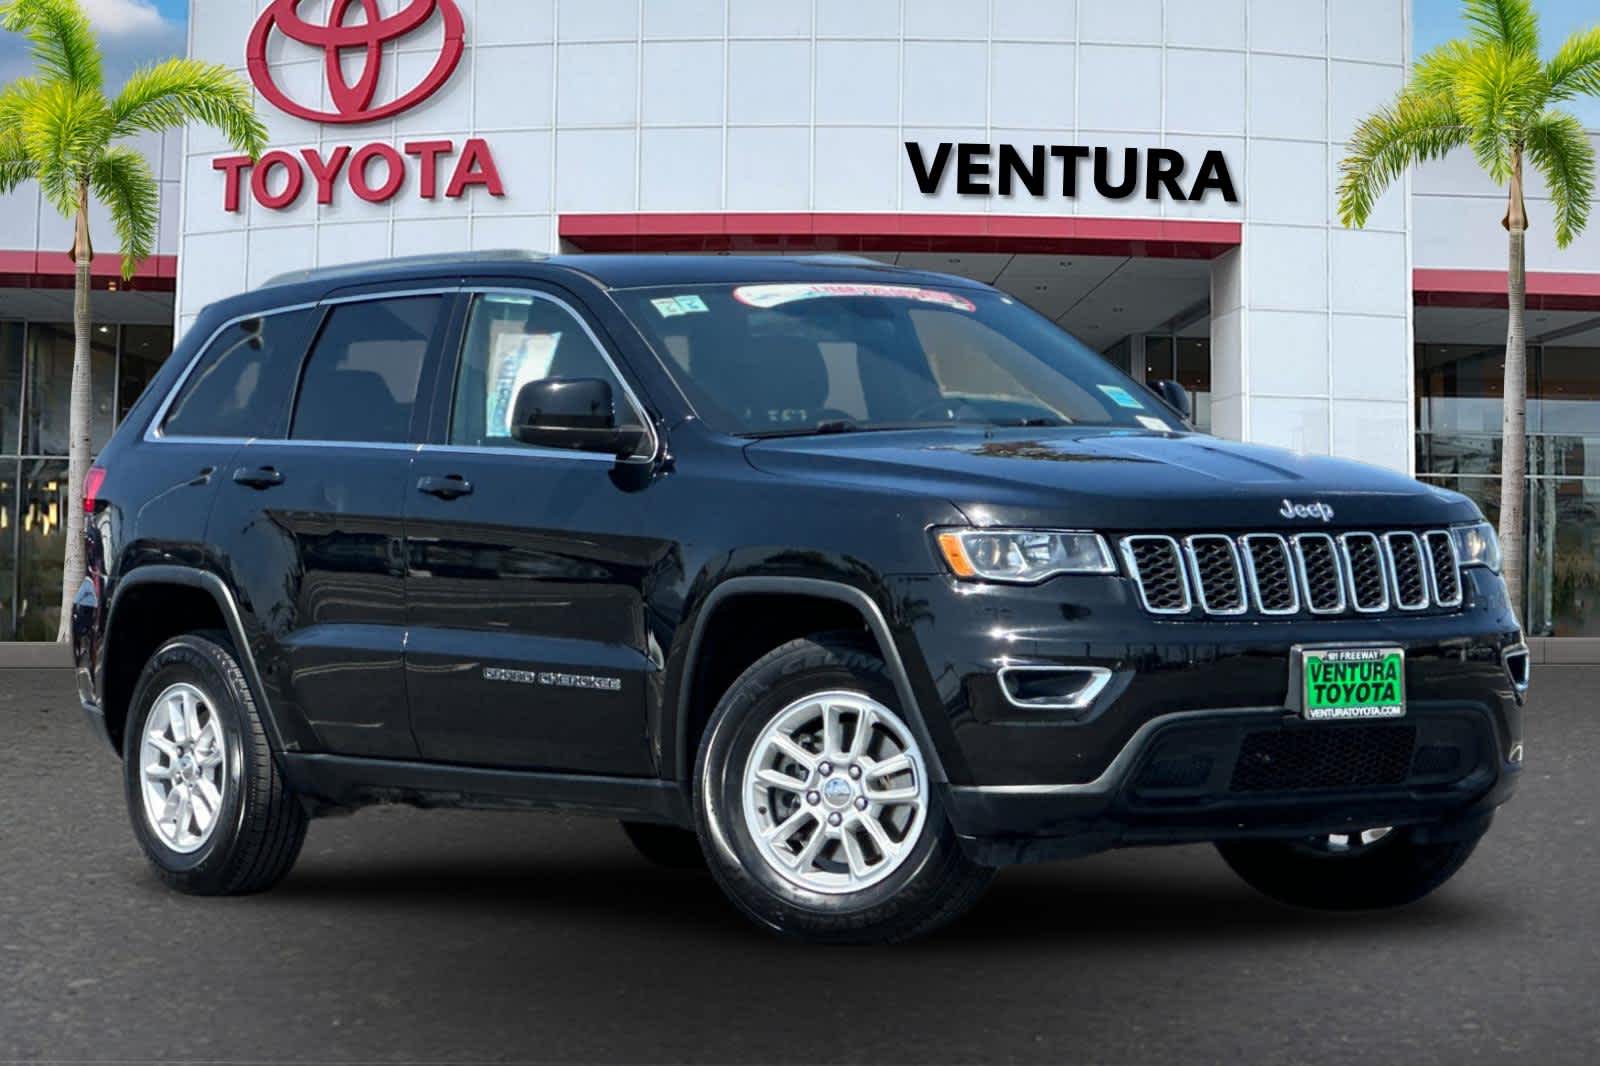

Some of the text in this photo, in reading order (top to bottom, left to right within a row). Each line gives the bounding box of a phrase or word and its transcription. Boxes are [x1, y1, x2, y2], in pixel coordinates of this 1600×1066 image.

[213, 138, 504, 212] TOYOTA
[904, 141, 1239, 203] VENTURA
[1280, 499, 1334, 522] Jeep
[1340, 650, 1379, 660] FREEWAY
[538, 672, 621, 690] CHEROKEE
[1311, 661, 1396, 682] VENTURA
[1314, 682, 1395, 704] TOYOTA
[1310, 706, 1401, 718] VENTURATOYOTA.COM
